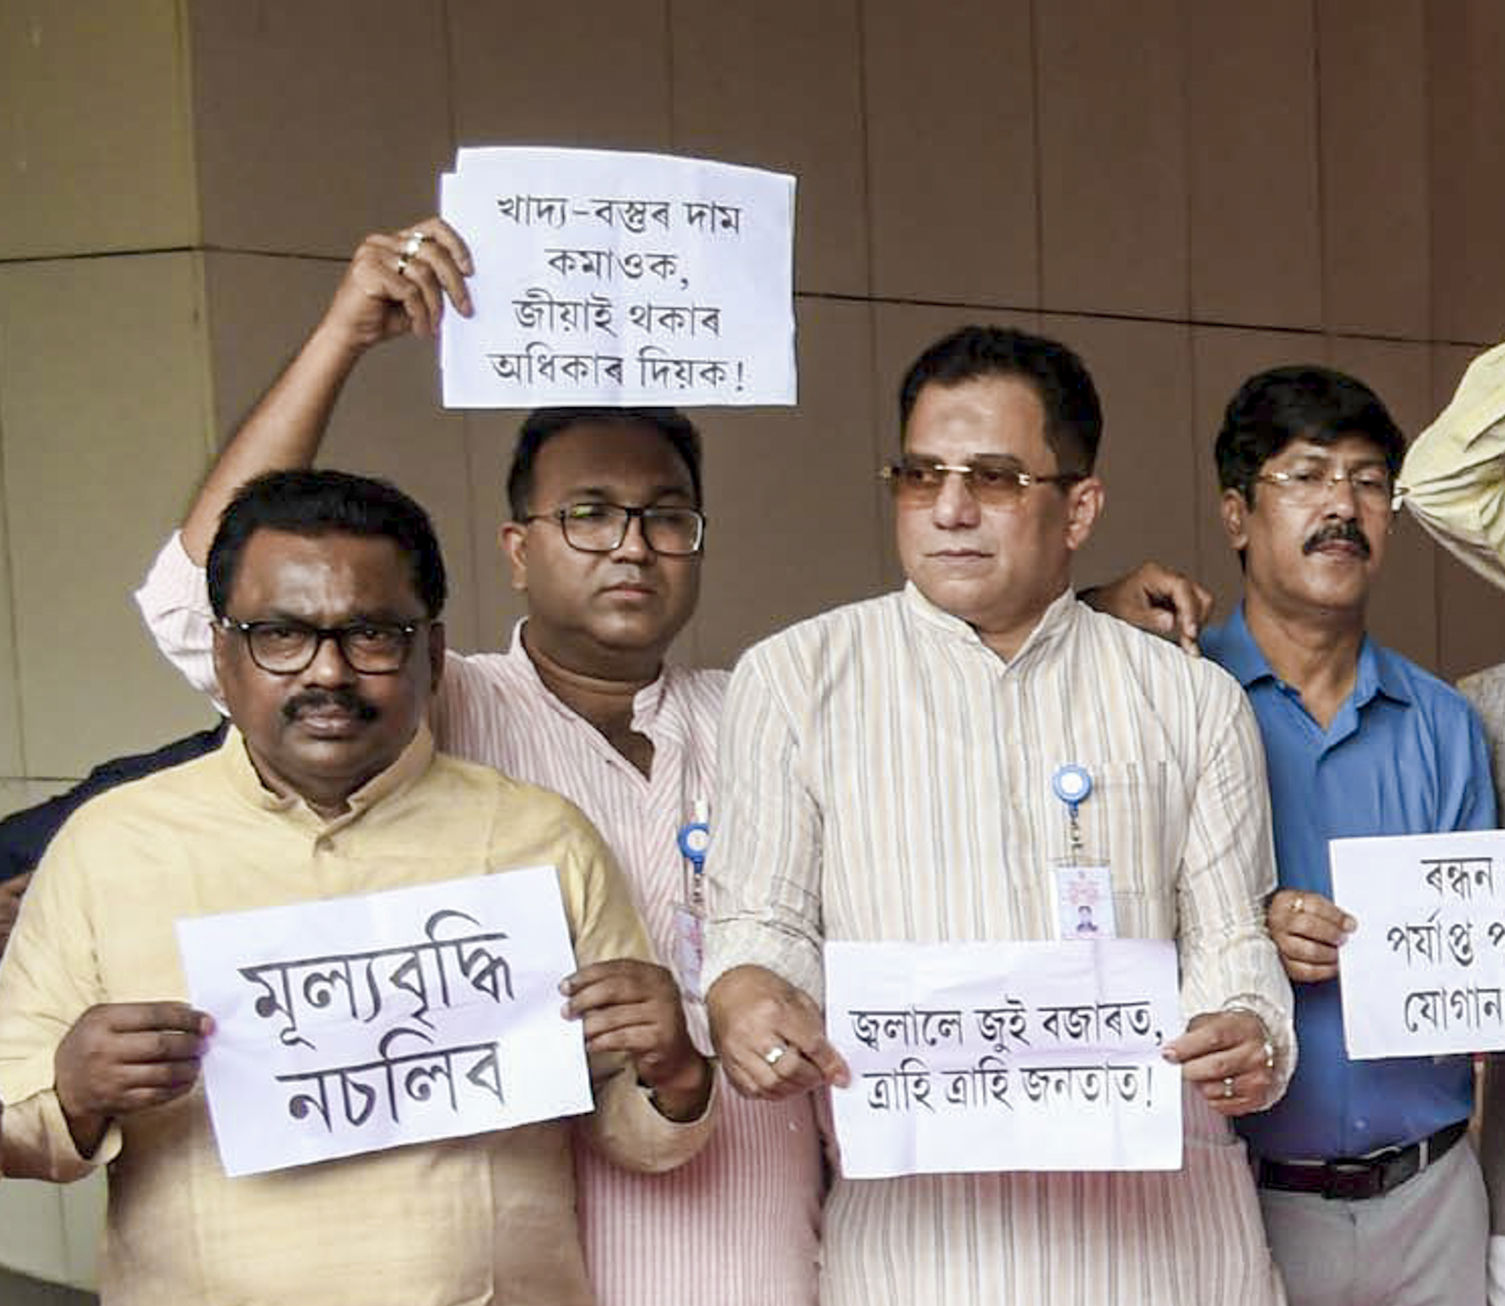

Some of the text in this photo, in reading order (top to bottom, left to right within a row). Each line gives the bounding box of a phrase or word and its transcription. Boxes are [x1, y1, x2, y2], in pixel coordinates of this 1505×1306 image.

[498, 195, 742, 234] খাদ্য-বস্তুৰ দাম
[545, 249, 688, 290] কমাওক,
[512, 288, 721, 338] জীয়াই থকাৰ
[488, 341, 624, 386] অধিকাৰ
[1420, 857, 1493, 899] ৰন্ধন
[1387, 909, 1473, 967] পৰ্যাপ্ত
[237, 910, 515, 1050] মূল্যবৃদ্ধি
[848, 998, 1162, 1053] জ্বলালে জুই বজাৰত,
[1405, 987, 1501, 1032] যোগান
[275, 1027, 504, 1133] নচলিব
